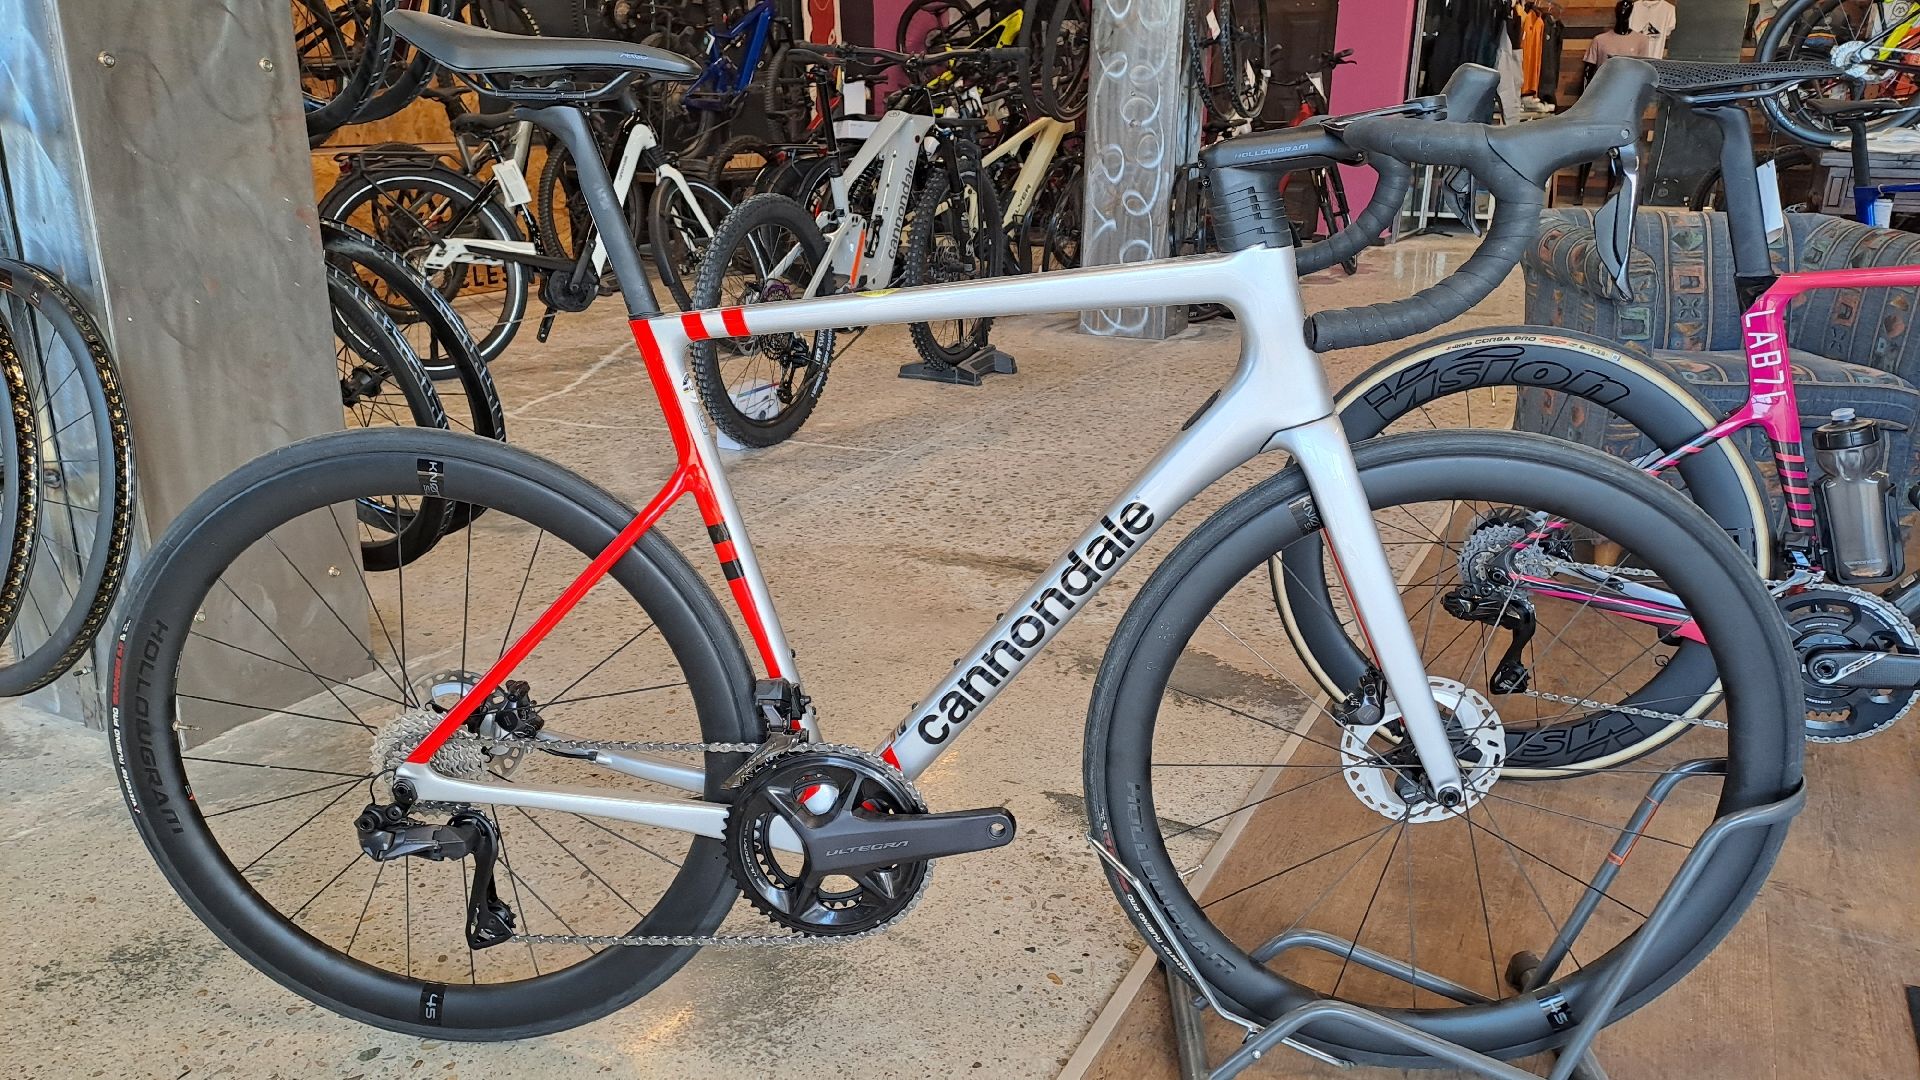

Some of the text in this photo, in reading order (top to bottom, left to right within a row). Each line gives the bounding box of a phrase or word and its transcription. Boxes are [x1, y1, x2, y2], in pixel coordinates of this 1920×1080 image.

[1234, 143, 1309, 159] HOLLOWGRAM
[887, 159, 916, 260] cannondale
[1474, 336, 1511, 345] CORSA
[917, 500, 1155, 746] cannondale
[112, 706, 120, 728] PRO
[134, 618, 185, 835] HOLLOWGRAM
[113, 728, 126, 766] RUBINO
[825, 839, 910, 858] ULTEGRA
[1126, 781, 1237, 974] HOLLOWGRAM
[1127, 893, 1141, 913] PRO
[1138, 912, 1164, 944] RUBINO
[425, 993, 438, 1019] 45
